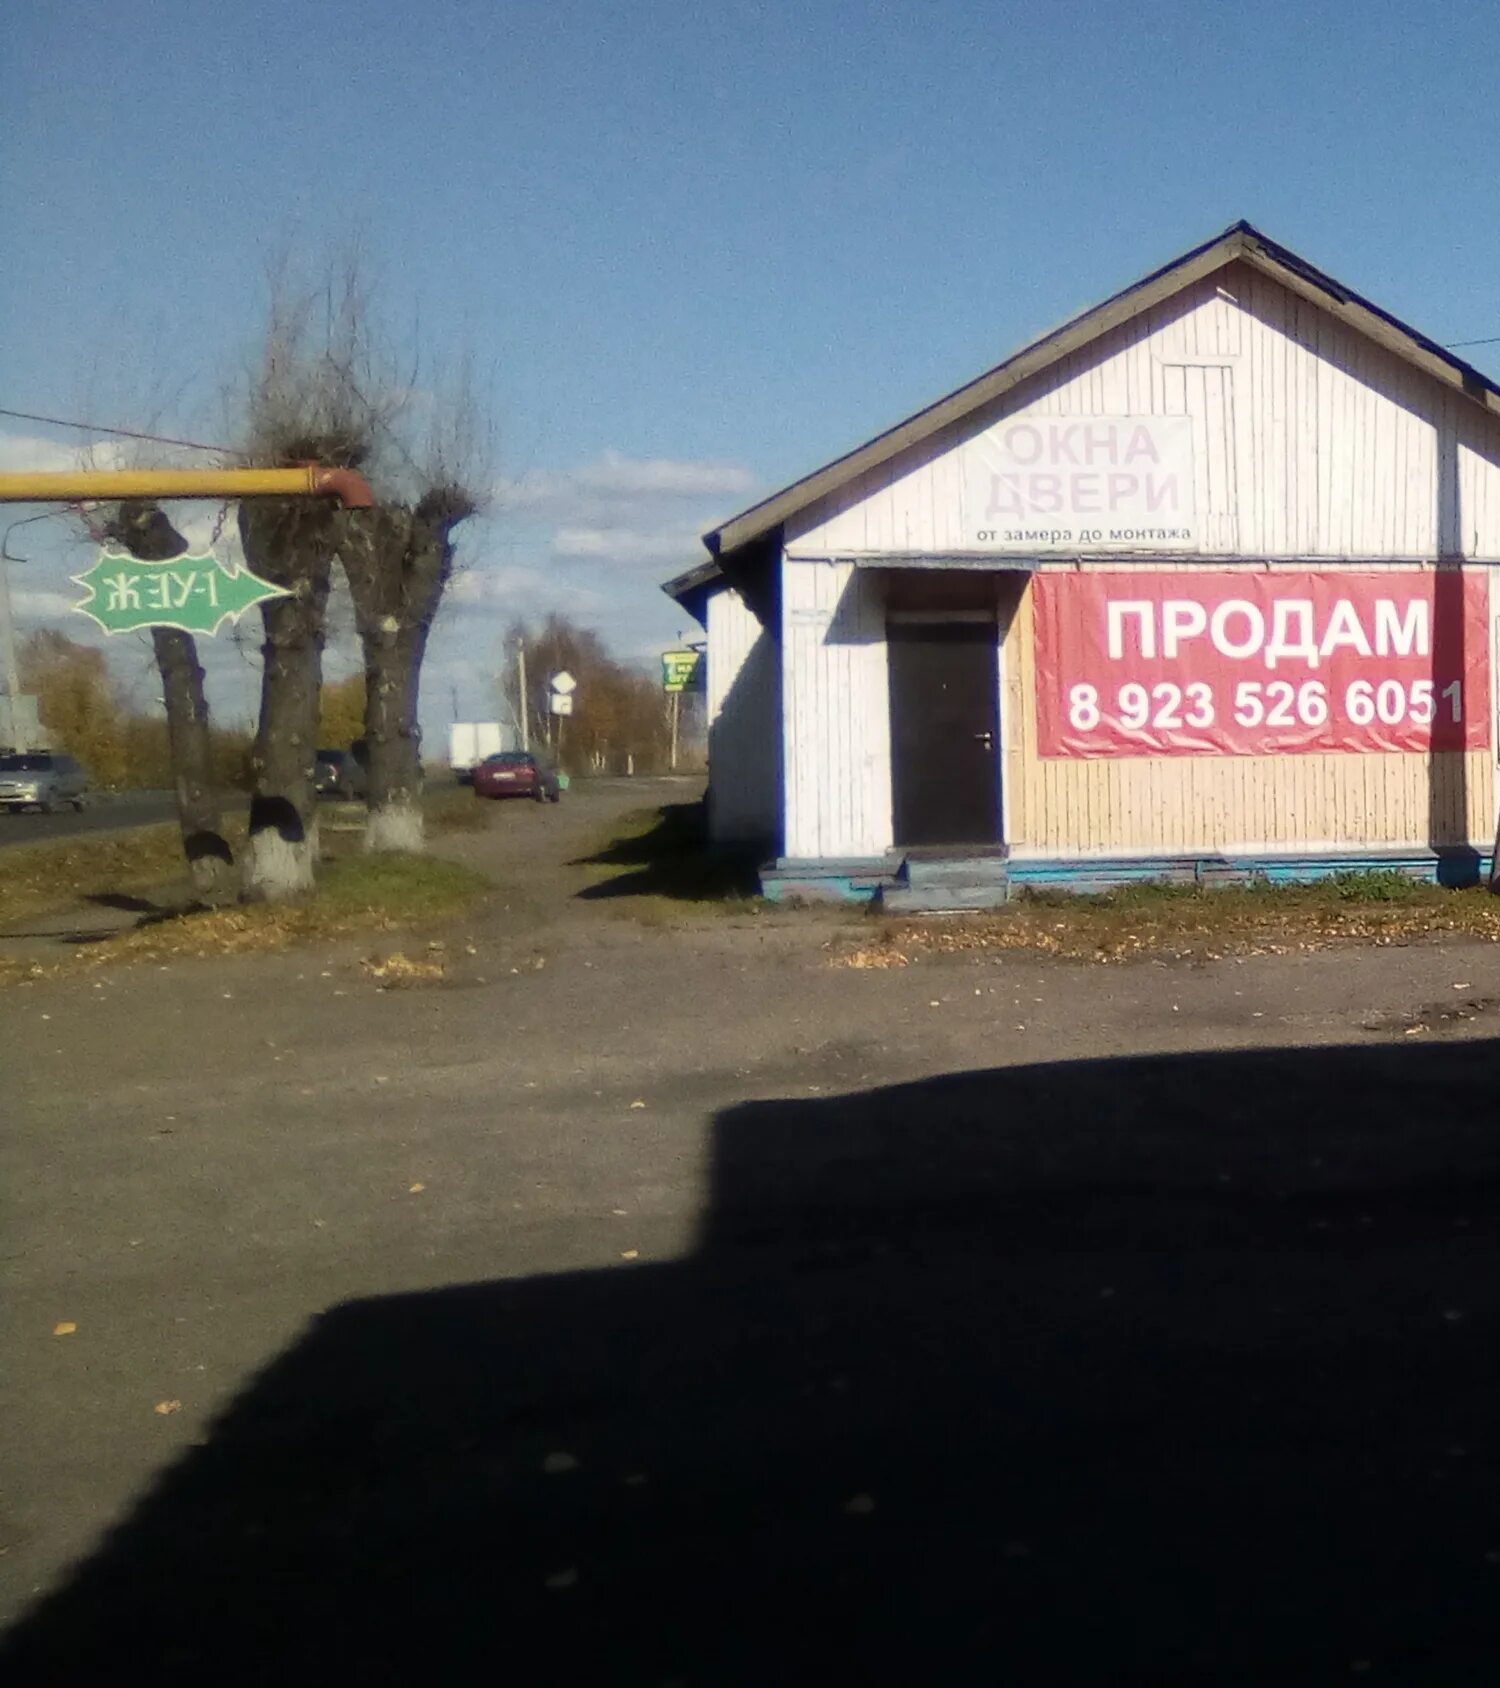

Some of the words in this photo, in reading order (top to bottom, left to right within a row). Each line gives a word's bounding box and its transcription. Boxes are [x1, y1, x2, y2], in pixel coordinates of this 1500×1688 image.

[1003, 423, 1161, 466] ОКНА
[985, 471, 1180, 521] ДВЕРИ
[976, 529, 998, 541] от
[1003, 528, 1072, 545] замера
[1078, 528, 1103, 544] до
[1109, 526, 1191, 541] монтажа
[1106, 599, 1430, 669] ПРОДАМ
[1069, 682, 1100, 731] 8
[1118, 682, 1216, 729] 923
[1233, 681, 1329, 728] 526
[1344, 679, 1463, 726] 6051
